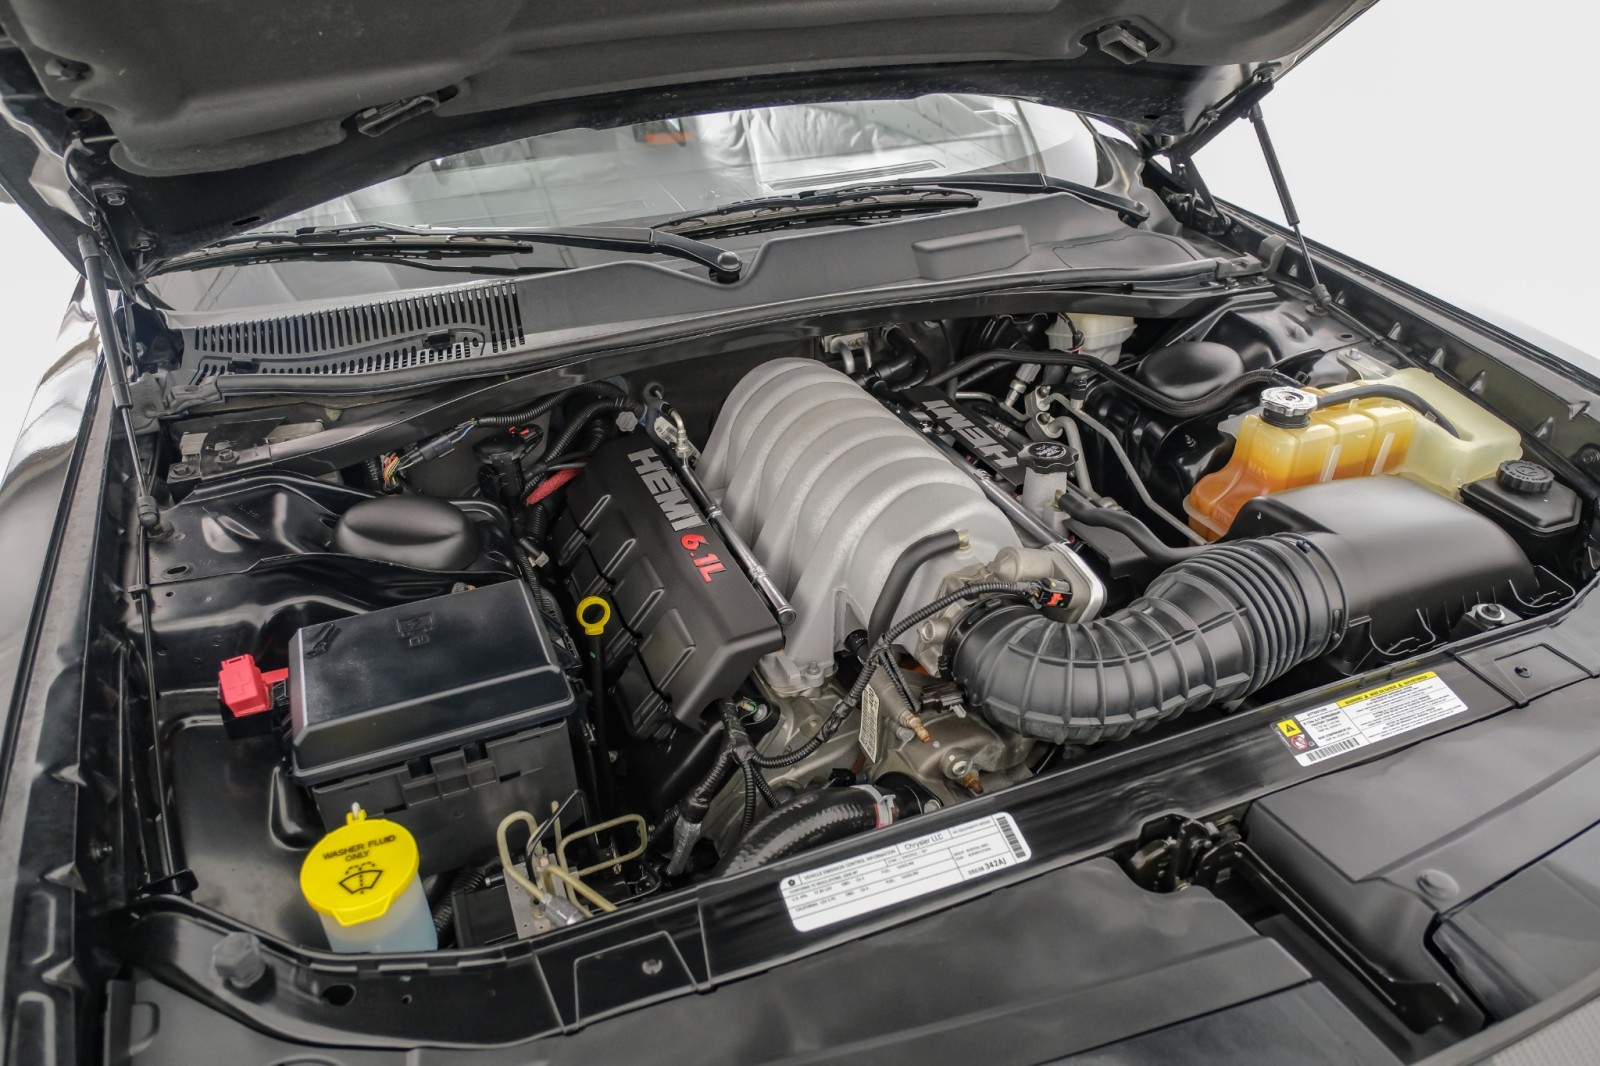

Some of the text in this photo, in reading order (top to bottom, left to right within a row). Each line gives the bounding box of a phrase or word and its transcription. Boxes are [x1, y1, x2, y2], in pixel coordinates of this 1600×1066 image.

[922, 399, 1019, 468] HEMI
[627, 447, 727, 584] HEMI 6.1L
[322, 835, 396, 860] WASHER FLUID
[903, 833, 943, 851] Chrysler LLC
[344, 850, 370, 862] ONLY
